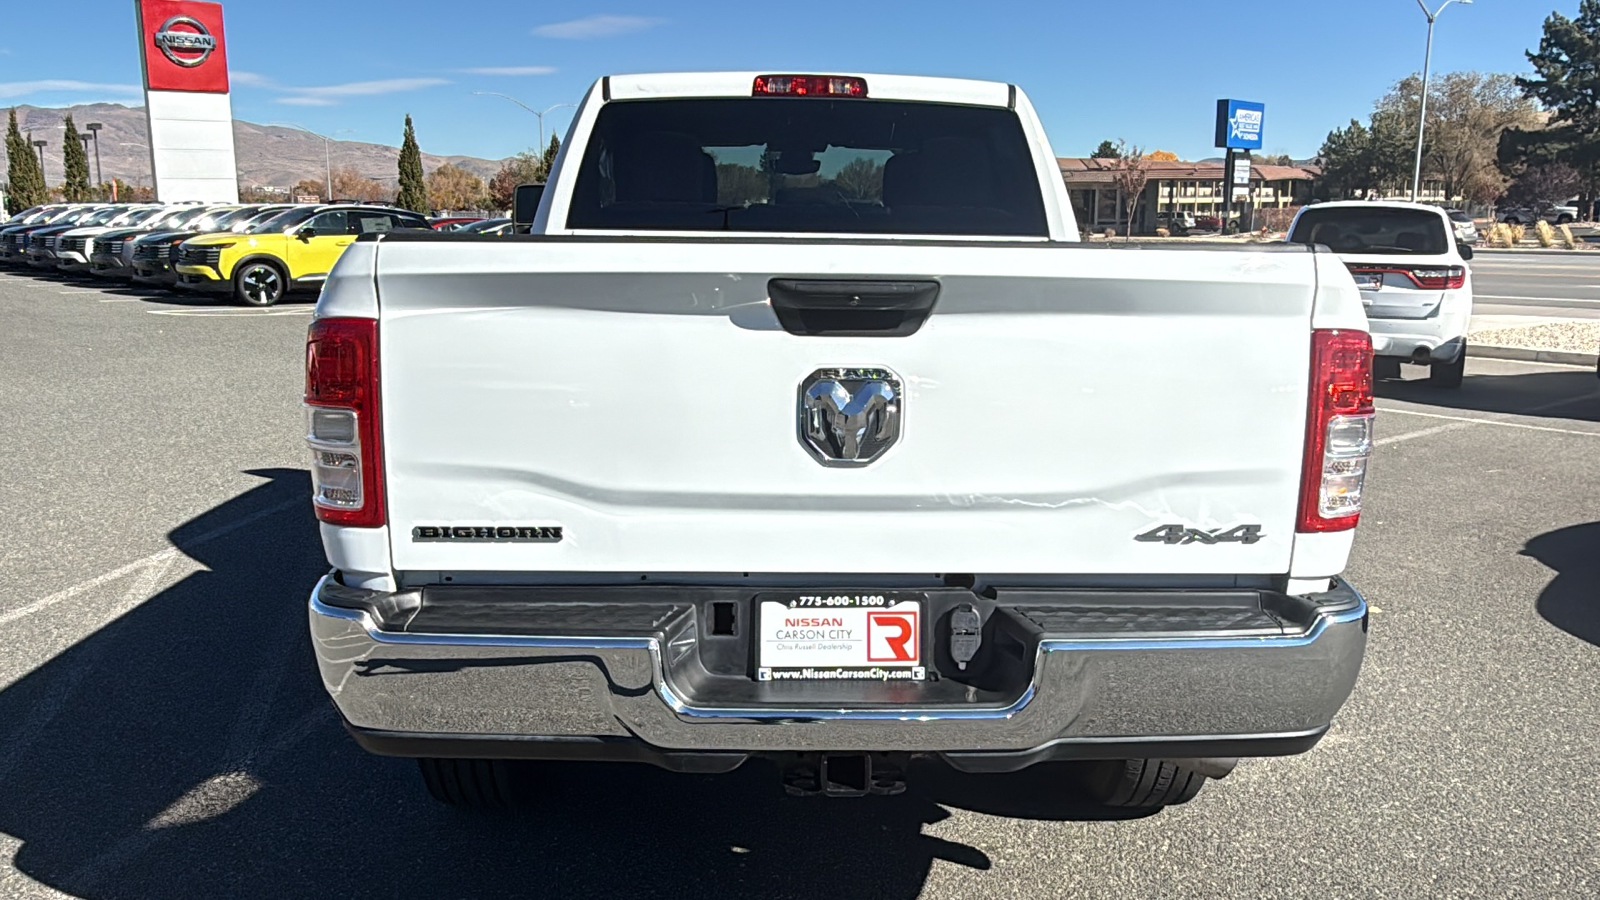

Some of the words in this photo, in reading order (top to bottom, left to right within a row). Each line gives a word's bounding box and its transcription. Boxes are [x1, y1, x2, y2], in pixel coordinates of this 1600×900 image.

[161, 34, 212, 46] NISSAN
[412, 526, 563, 543] BIGHORN
[799, 595, 884, 606] 775-600-1500
[785, 617, 843, 627] NISSAN
[776, 629, 825, 639] CARSON
[828, 629, 852, 639] CITY
[817, 643, 853, 651] Dealership
[772, 668, 912, 681] www.NissanCarsonCity.com
